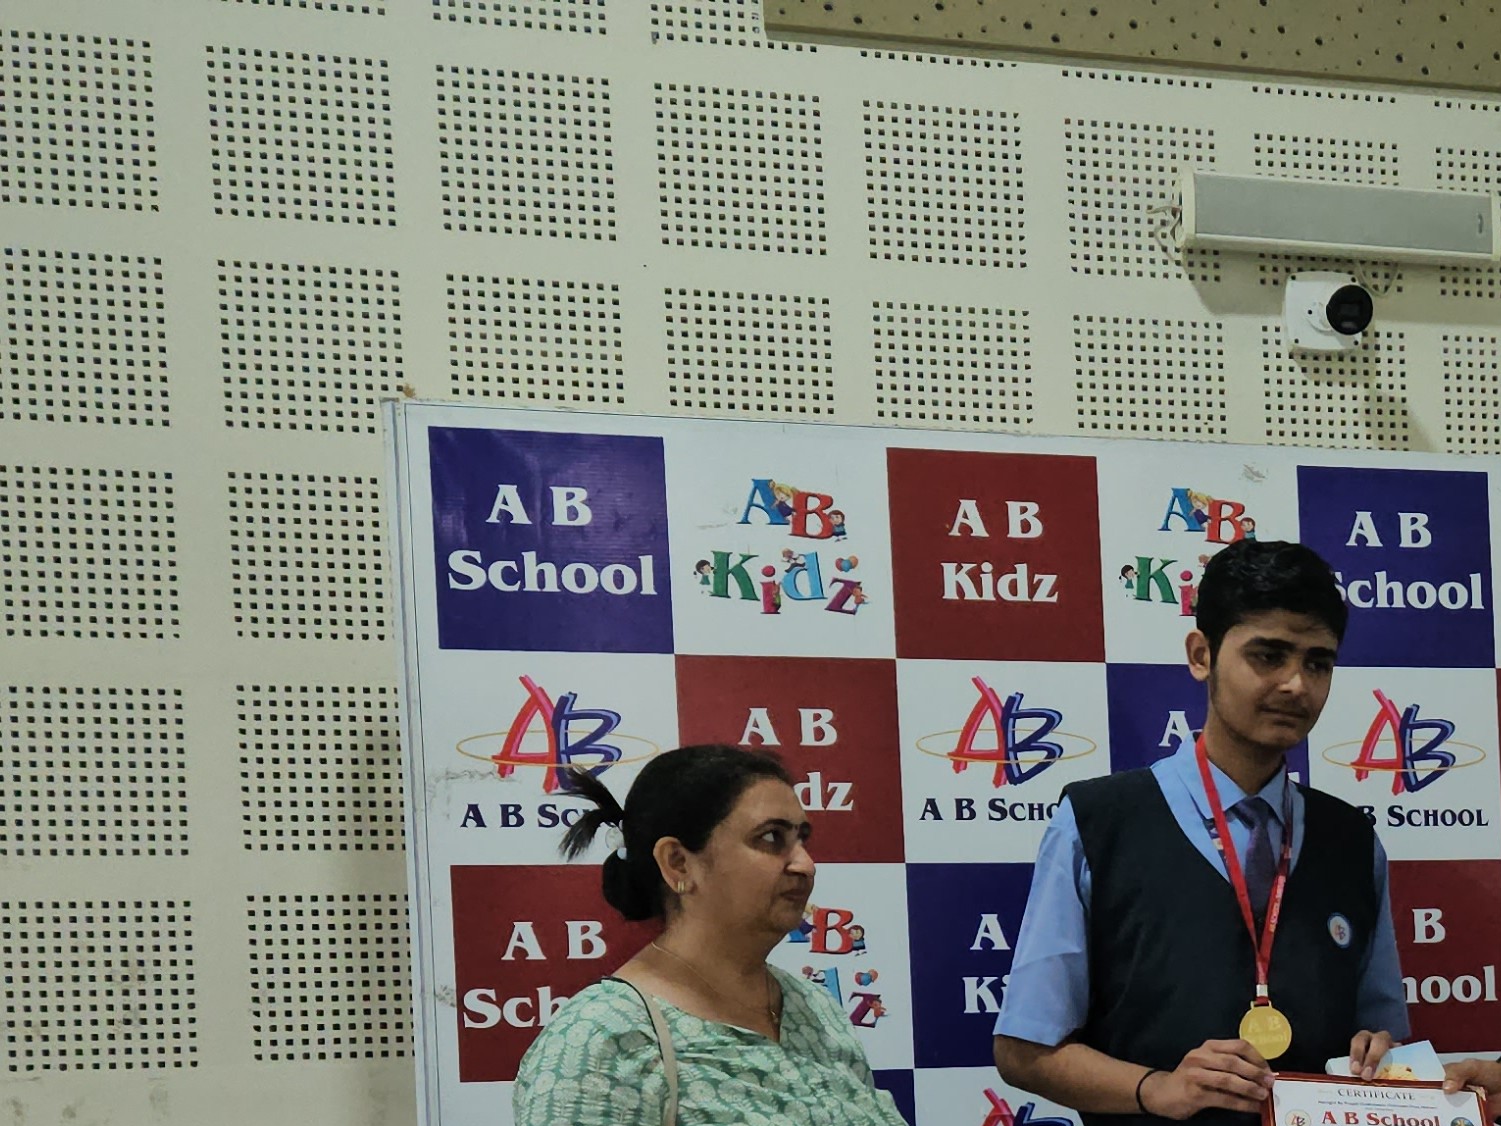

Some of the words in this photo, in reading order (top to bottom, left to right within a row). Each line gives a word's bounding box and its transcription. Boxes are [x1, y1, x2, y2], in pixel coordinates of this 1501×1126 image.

[486, 484, 531, 525] A
[549, 486, 593, 527] B
[948, 498, 989, 538] A
[1005, 500, 1044, 540] B
[1345, 511, 1384, 547] A
[1398, 512, 1432, 548] B
[447, 549, 659, 596] School
[709, 548, 867, 617] Kidz
[941, 560, 1060, 604] Kidz
[1132, 555, 1199, 617] Ki
[737, 707, 781, 746] A
[798, 707, 838, 747] B
[1158, 710, 1191, 748] A
[792, 771, 854, 812] dz
[919, 798, 944, 821] A
[954, 798, 977, 821] B
[460, 803, 488, 828] A
[499, 803, 525, 828] B
[500, 921, 548, 961] A
[564, 920, 607, 960] B
[970, 913, 1011, 951] A
[1411, 907, 1446, 944] B
[462, 985, 571, 1029] Sch
[1337, 1088, 1416, 1101] CERTIFICATE
[1321, 1110, 1337, 1125] A
[1343, 1111, 1359, 1126] B
